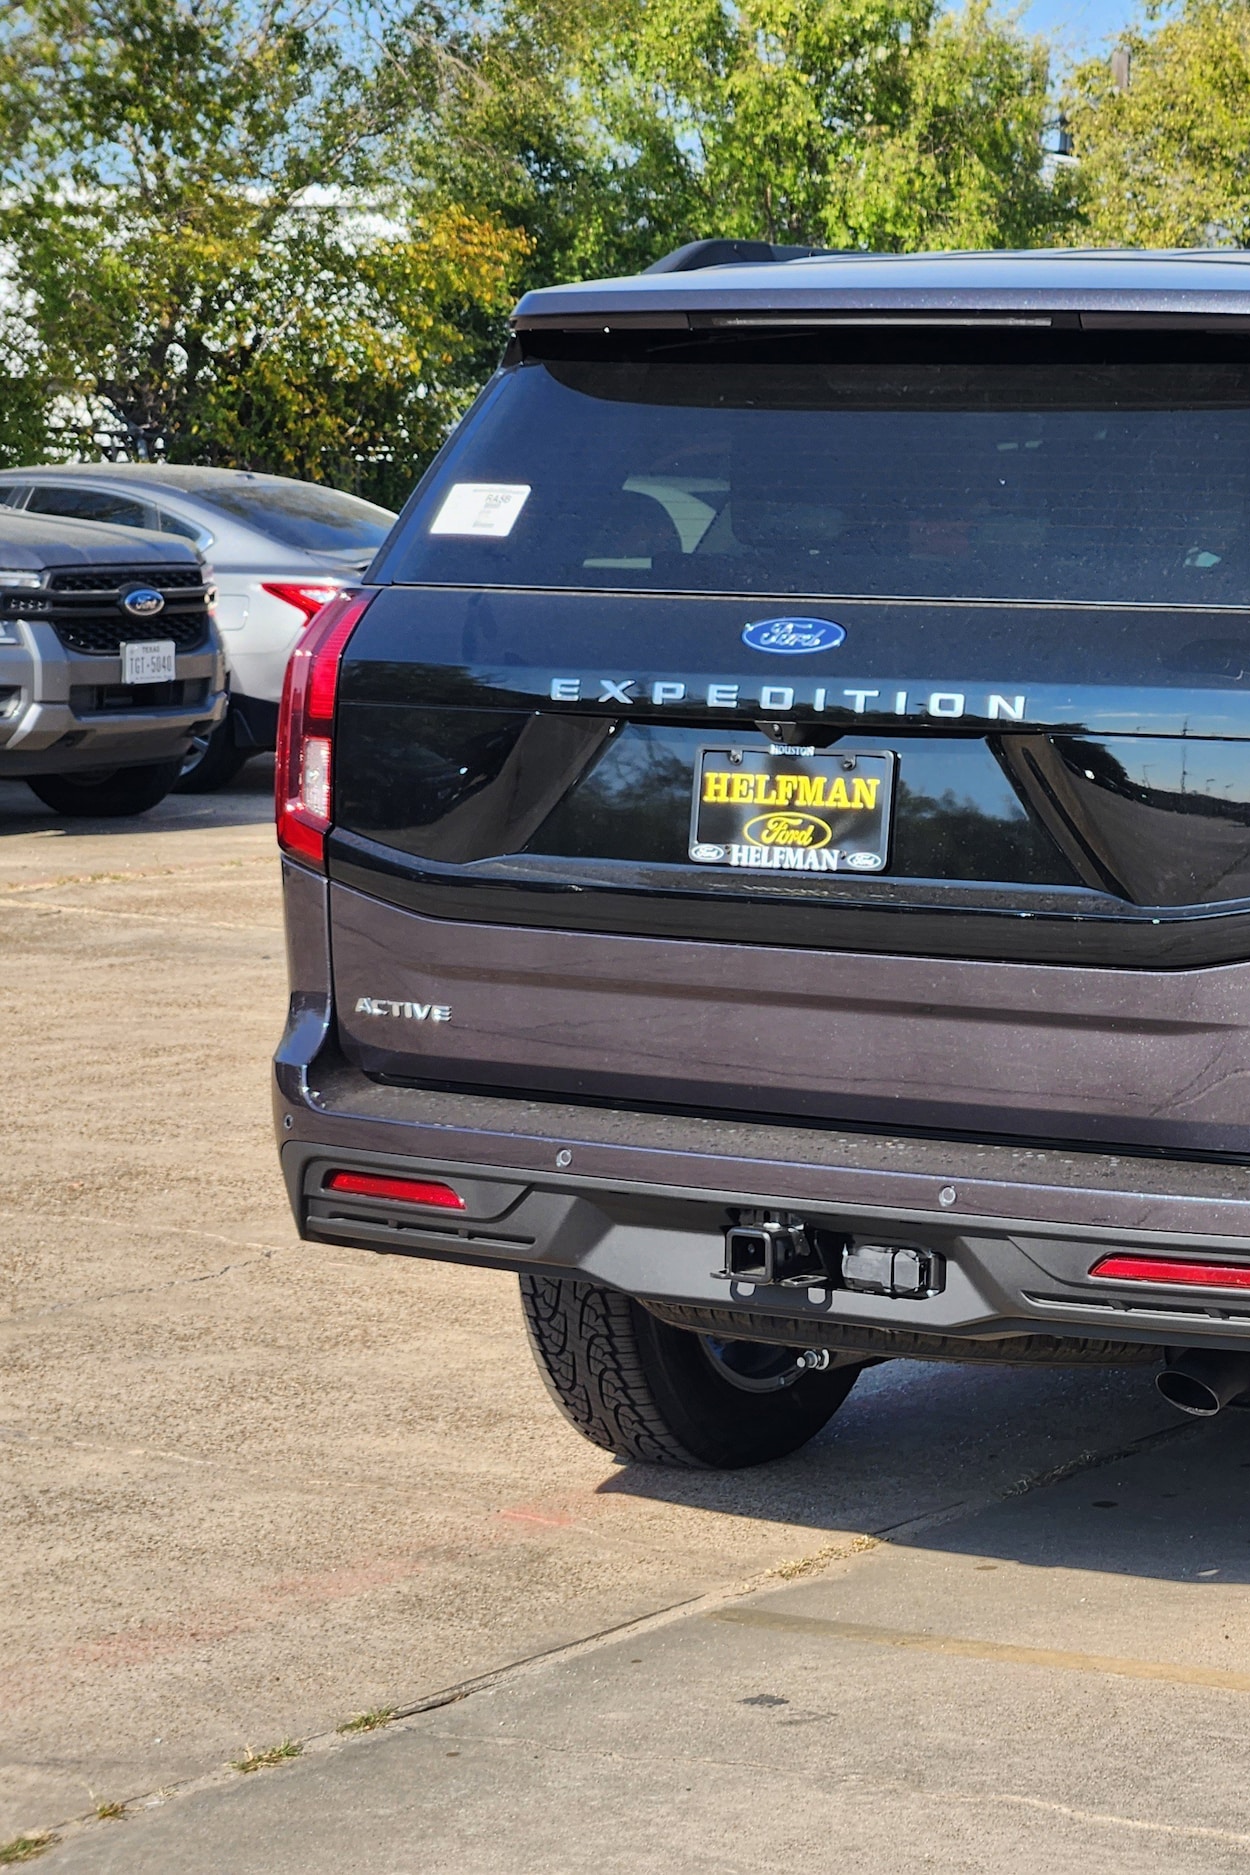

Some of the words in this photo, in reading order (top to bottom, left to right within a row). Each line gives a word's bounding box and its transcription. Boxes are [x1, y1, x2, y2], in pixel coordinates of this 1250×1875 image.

[760, 622, 826, 647] Ford
[550, 677, 1026, 720] EXPEDITION
[769, 743, 815, 757] HOUSTON
[703, 772, 880, 809] HELFMAN
[761, 815, 815, 845] Ford
[730, 844, 840, 871] HELFMAN
[354, 997, 452, 1021] ACTIVE
